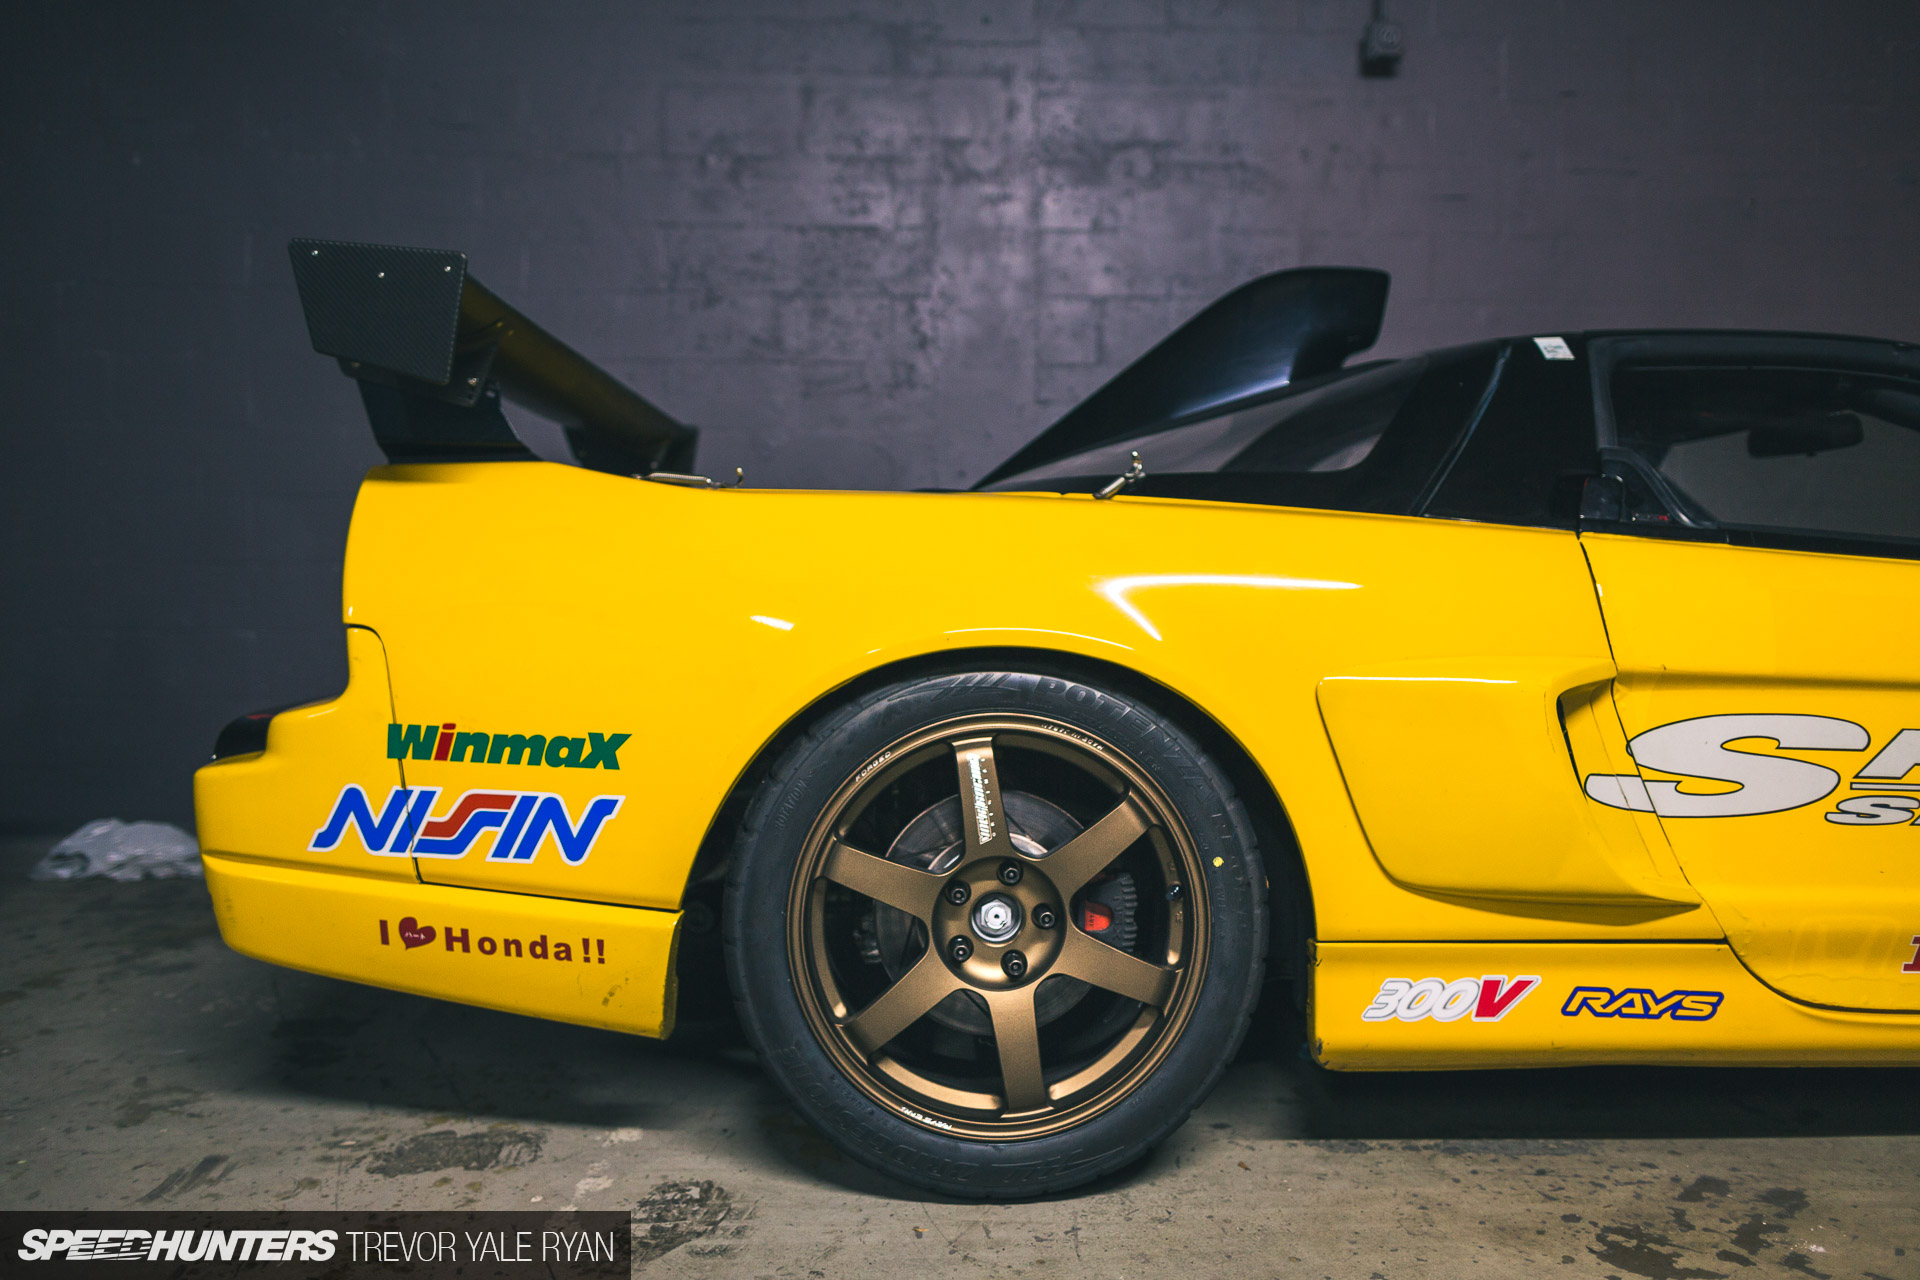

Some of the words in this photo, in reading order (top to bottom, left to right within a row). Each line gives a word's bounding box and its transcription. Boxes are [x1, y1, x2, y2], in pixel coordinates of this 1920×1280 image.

[1033, 676, 1221, 801] POTENZA
[855, 751, 892, 783] FORGED
[1362, 975, 1542, 1022] 300V
[1561, 986, 1724, 1021] RAYS
